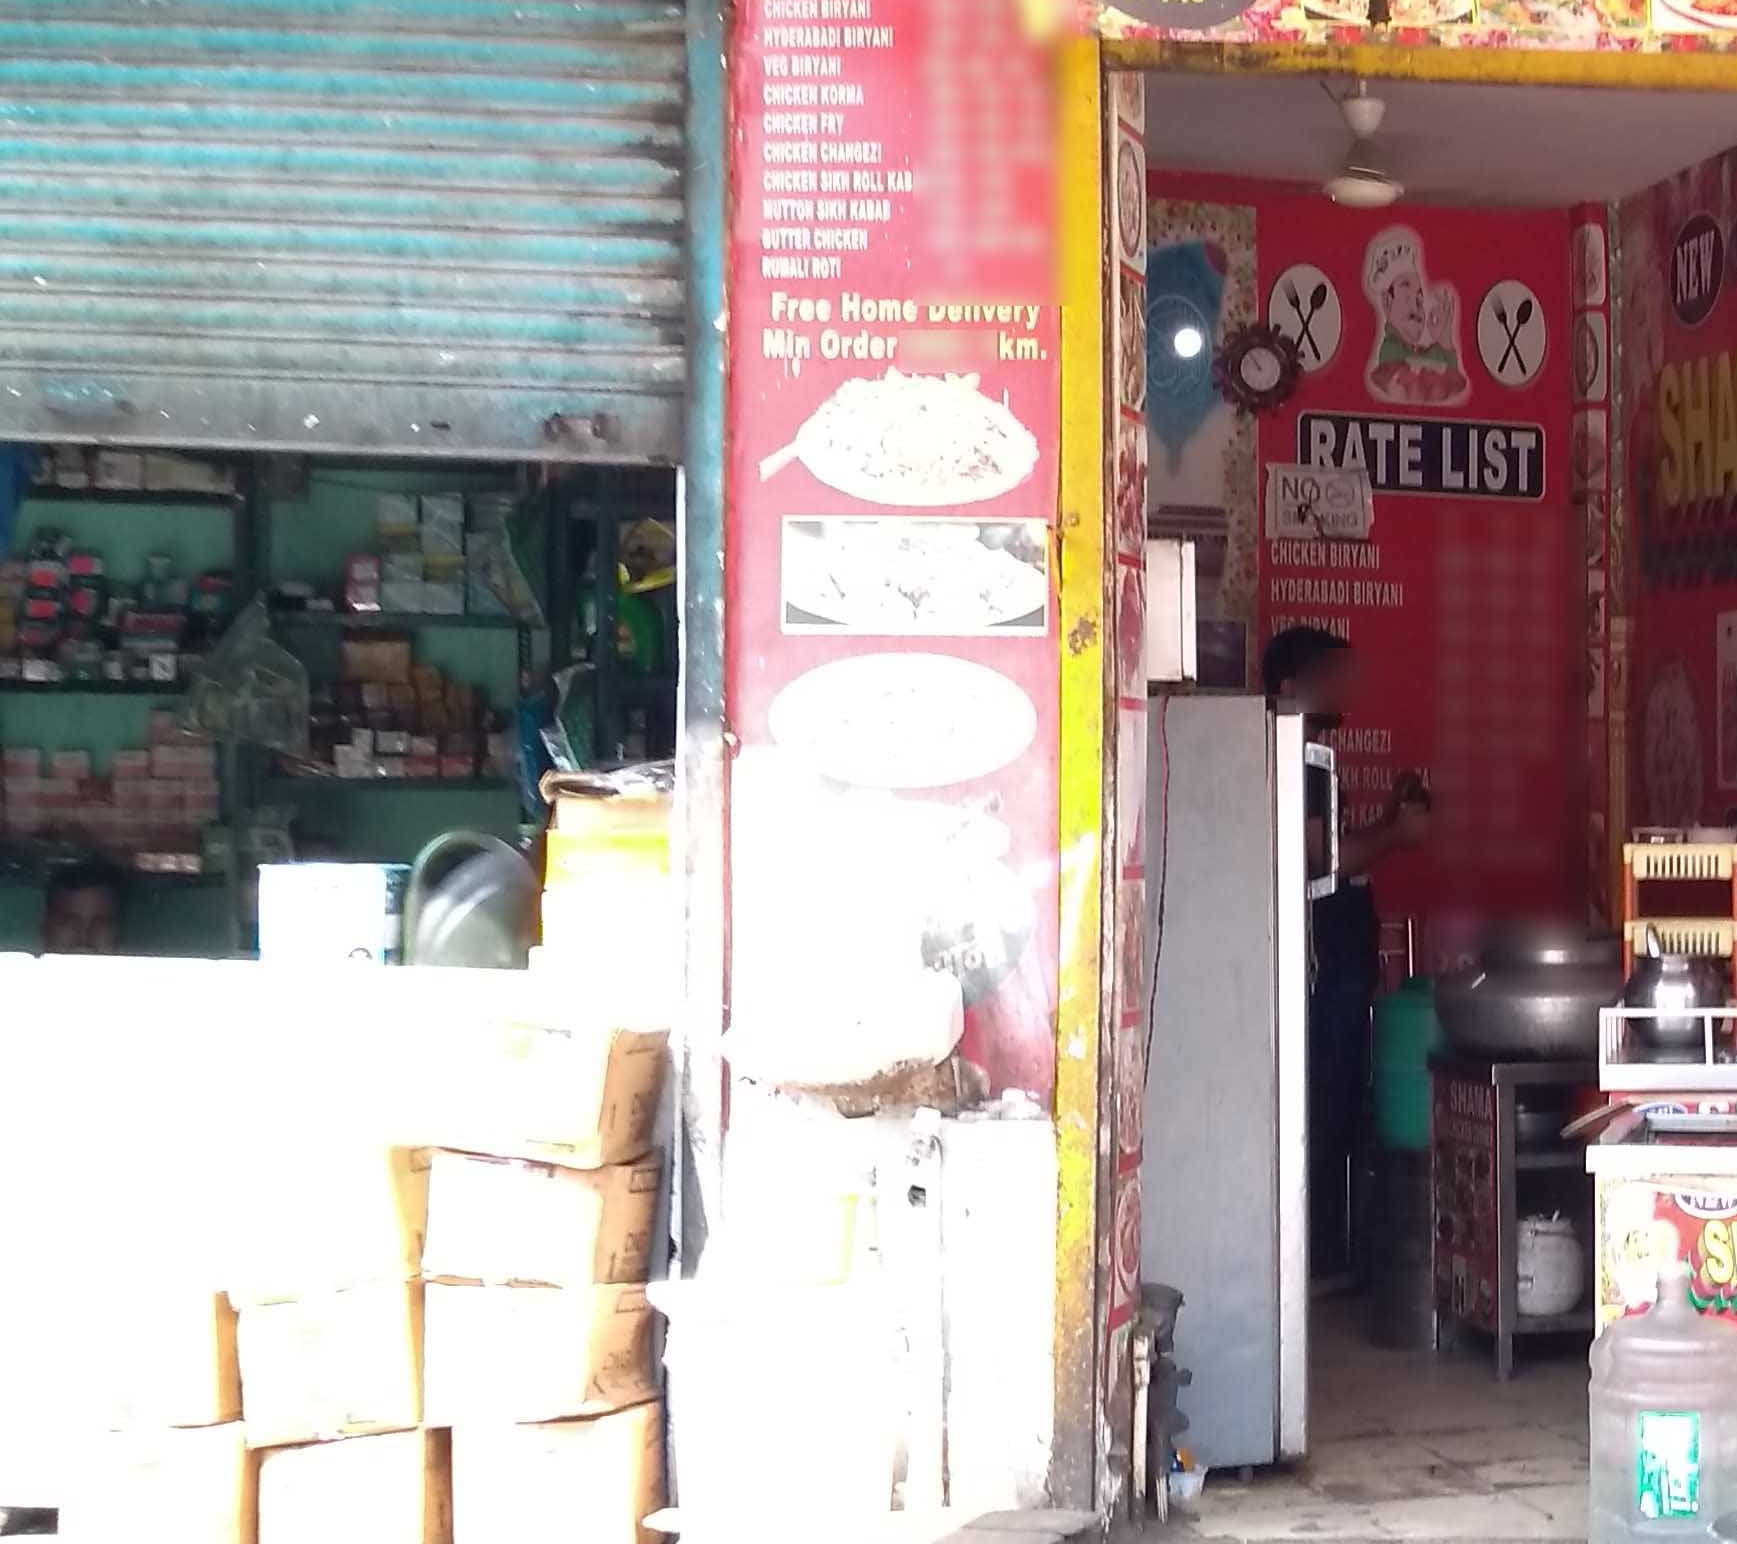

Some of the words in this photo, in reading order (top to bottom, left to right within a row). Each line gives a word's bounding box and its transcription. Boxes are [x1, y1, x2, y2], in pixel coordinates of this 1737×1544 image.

[763, 26, 840, 49] HYDERABADI
[843, 26, 894, 48] BIRYANI
[763, 55, 789, 77] VEG
[791, 55, 841, 77] BIRYANI
[763, 83, 818, 106] CHICKEN
[820, 84, 865, 106] KORMA
[763, 112, 818, 135] CHICKEN
[820, 112, 844, 136] FRY
[763, 141, 817, 164] CHICKEN
[763, 170, 817, 192] CHICKEN
[852, 170, 884, 192] ROLL
[887, 171, 913, 192] KAB
[763, 199, 814, 221] MUTTON
[761, 227, 811, 250] BUTTER
[813, 228, 868, 250] CHICKEN
[761, 256, 809, 279] RUMALI
[812, 256, 841, 279] ROTI
[1676, 229, 1715, 304] NEW
[770, 292, 831, 323] Free
[840, 292, 917, 323] Home
[762, 329, 810, 360] Min
[819, 328, 898, 360] Order
[1310, 419, 1424, 489] RATE
[1442, 426, 1536, 493] LIST
[1282, 476, 1320, 504] NO
[1271, 541, 1326, 567] CHICKEN
[1330, 542, 1380, 569] BIRYANI
[1271, 578, 1350, 605] HYDERABADI
[1353, 581, 1403, 607] BIRYANI
[1450, 1080, 1493, 1121] SHAMA
